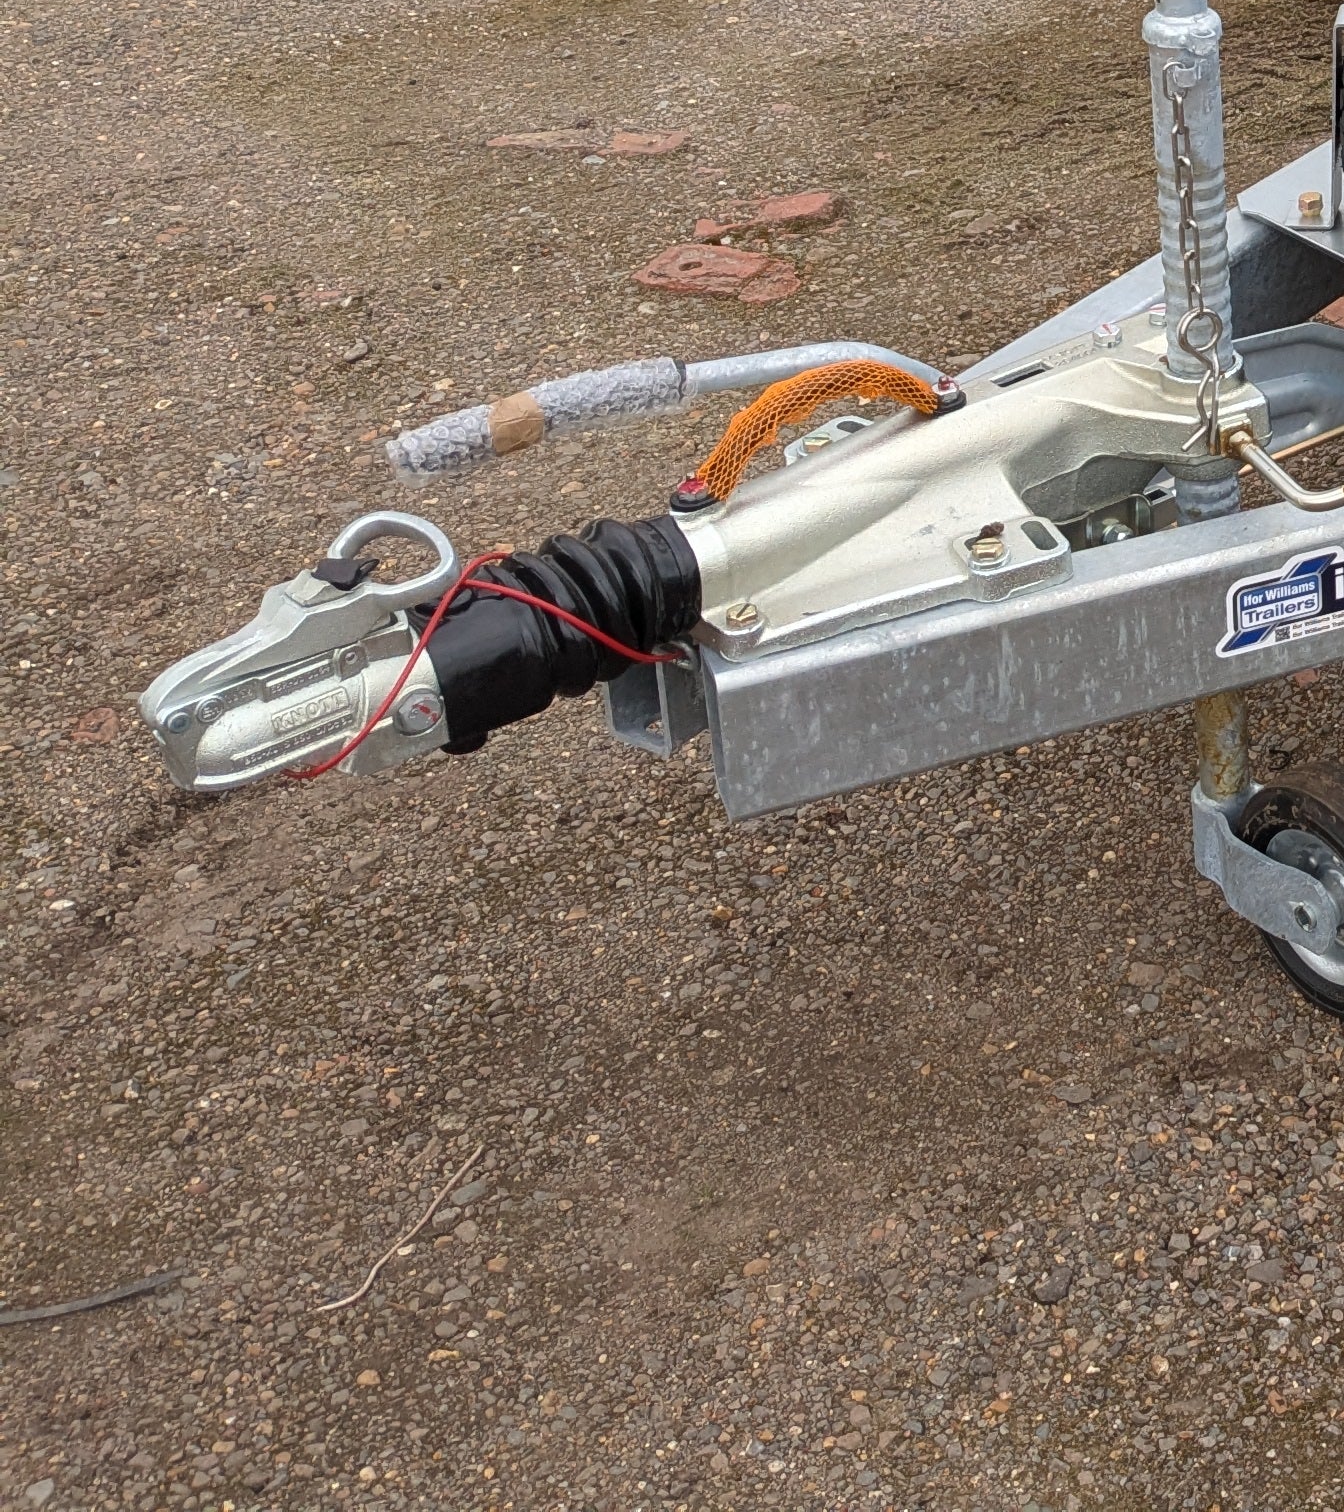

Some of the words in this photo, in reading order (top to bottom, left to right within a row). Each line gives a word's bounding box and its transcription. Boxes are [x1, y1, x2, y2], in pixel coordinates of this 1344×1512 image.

[1244, 594, 1264, 607] Ifor
[1264, 581, 1315, 602] Williams
[1244, 596, 1316, 624] Trailers
[272, 688, 348, 732] KNOTT
